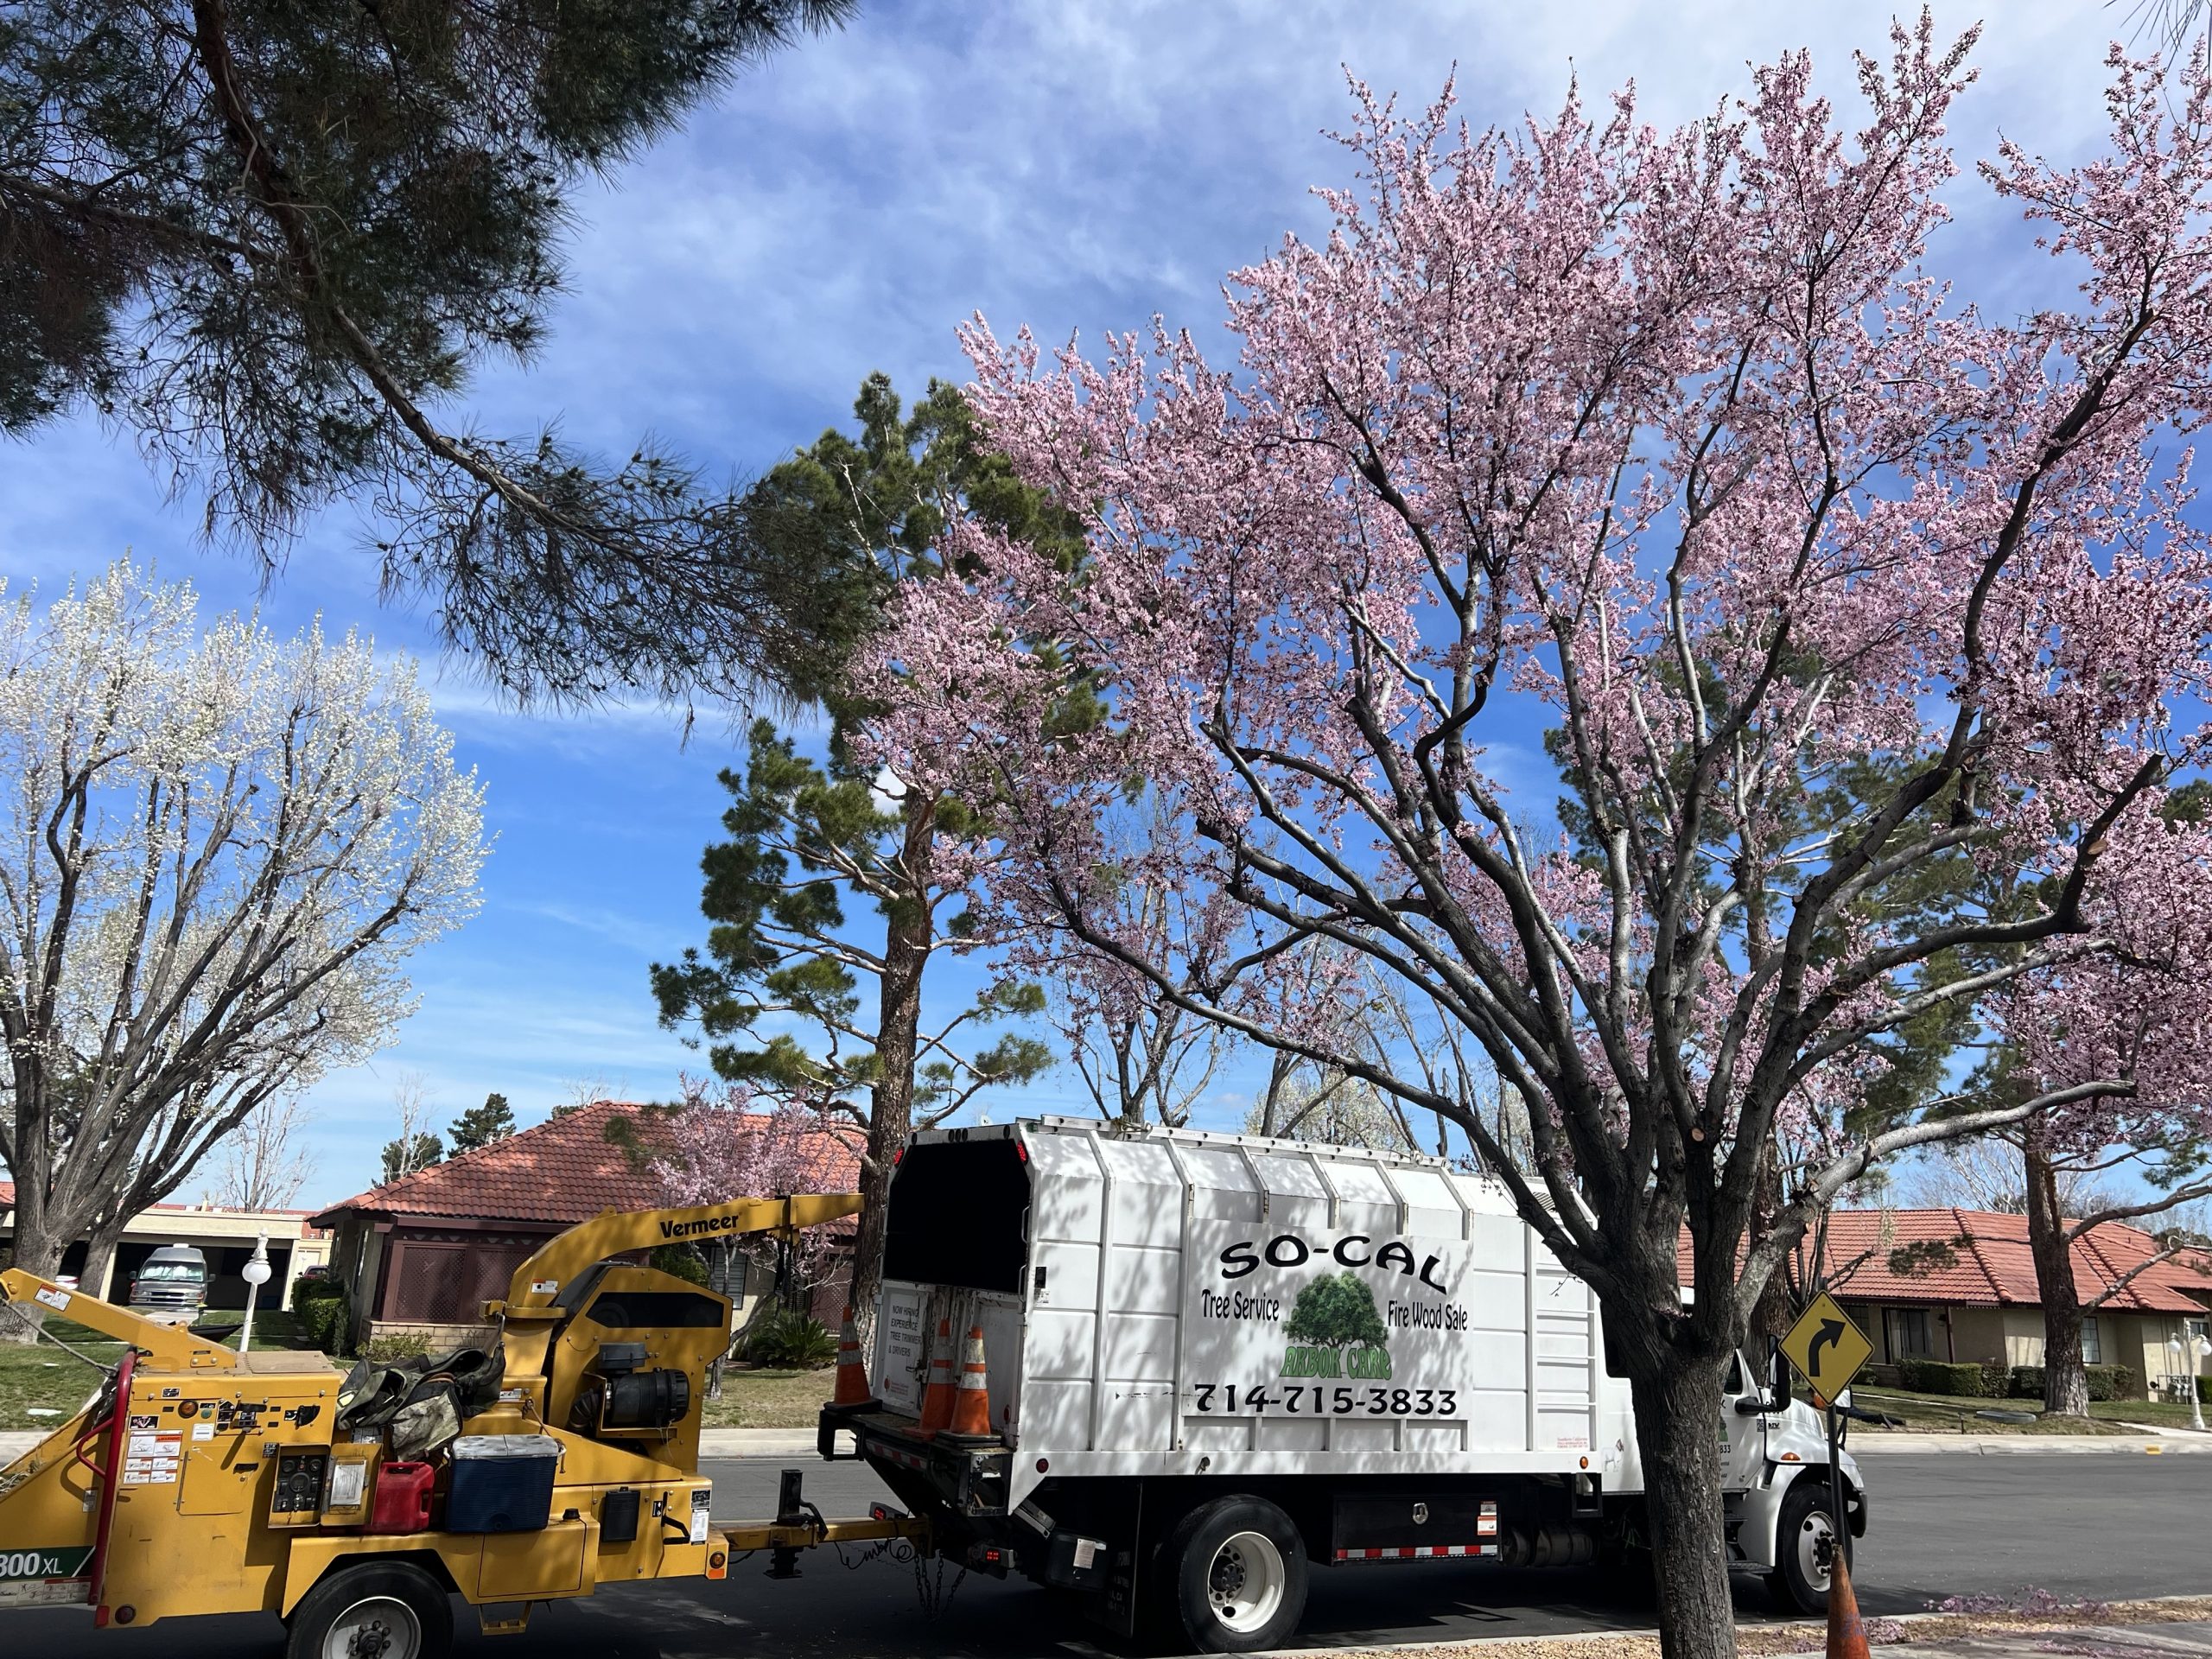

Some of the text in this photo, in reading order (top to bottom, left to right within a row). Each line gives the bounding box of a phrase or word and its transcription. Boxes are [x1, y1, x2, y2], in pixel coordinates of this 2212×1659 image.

[659, 1215, 739, 1238] Vermeer
[1220, 1235, 1447, 1295] SO-CAL
[1202, 1289, 1280, 1321] Tree Service
[1389, 1300, 1468, 1332] Fire Wood Sale
[890, 1332, 900, 1341] TREE
[893, 1346, 911, 1357] DRIVERS
[1279, 1346, 1392, 1380] ARBOR CARE
[1194, 1384, 1457, 1414] 714-715-3833
[41, 1558, 63, 1574] XL
